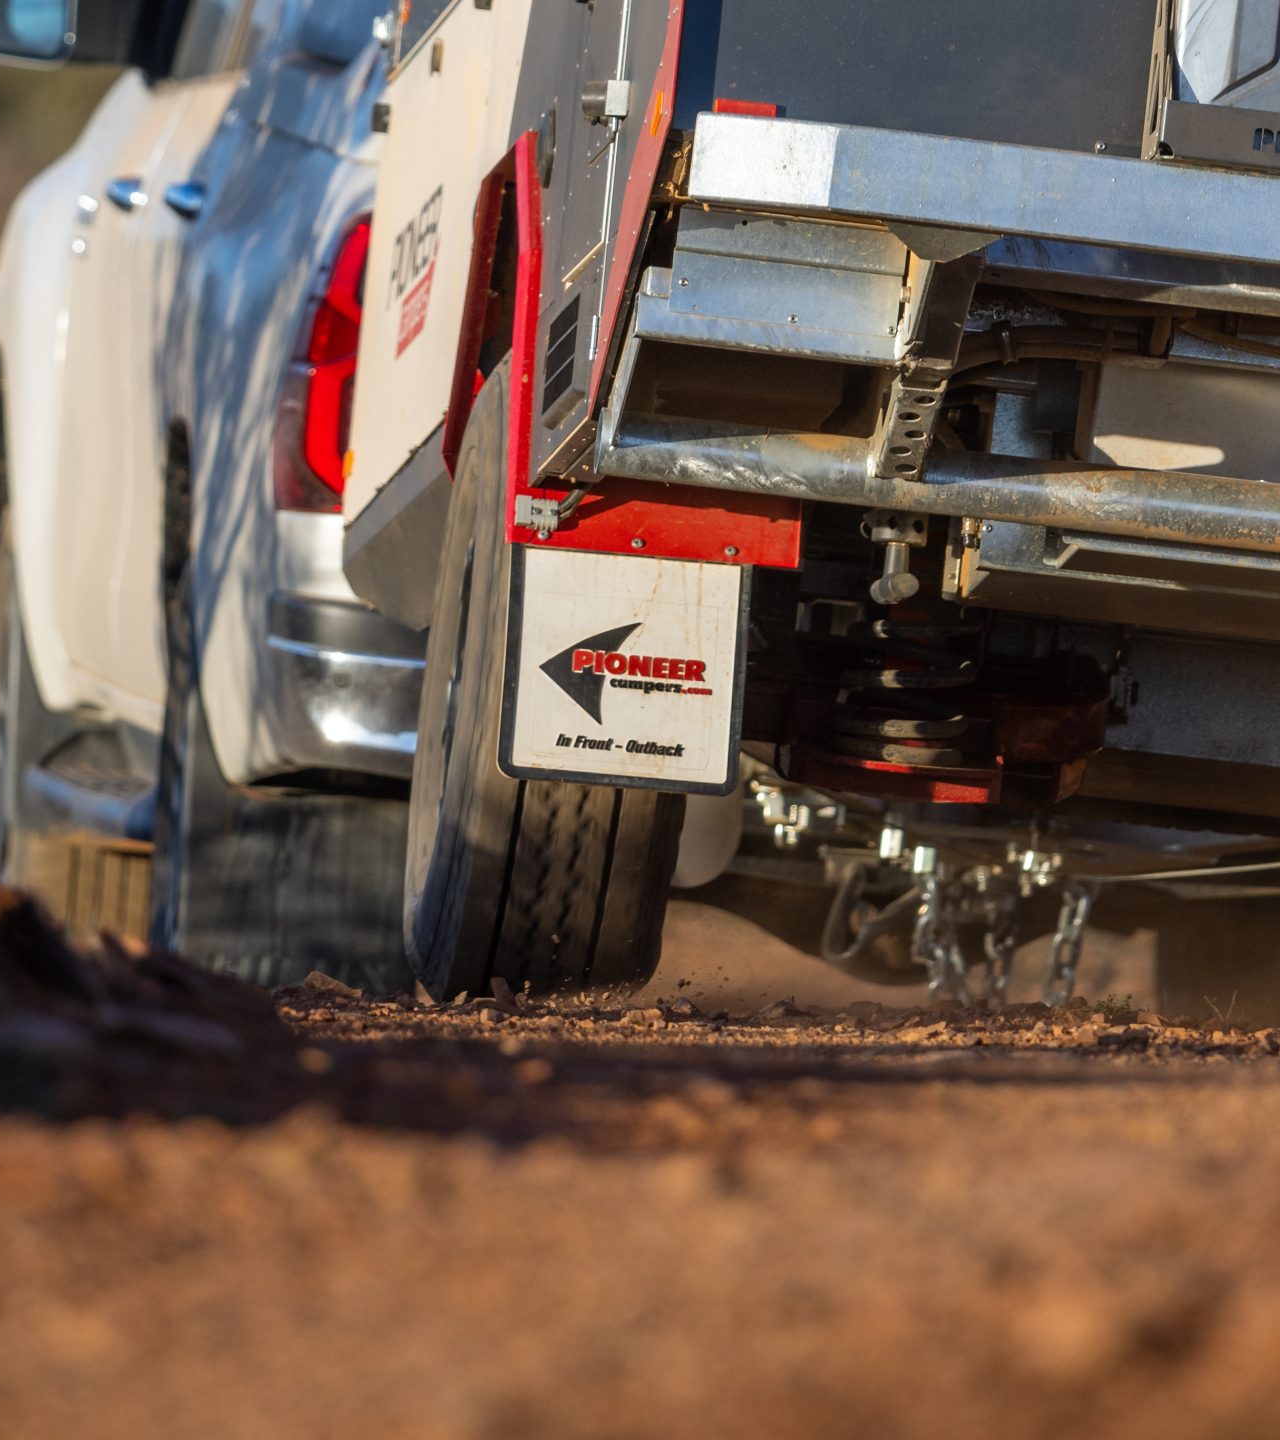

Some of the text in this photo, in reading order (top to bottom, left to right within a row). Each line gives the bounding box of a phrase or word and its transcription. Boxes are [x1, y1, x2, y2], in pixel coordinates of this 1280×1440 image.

[572, 648, 706, 682] PIONEER
[556, 733, 572, 748] In
[573, 735, 614, 751] Front
[625, 739, 686, 758] Outback
